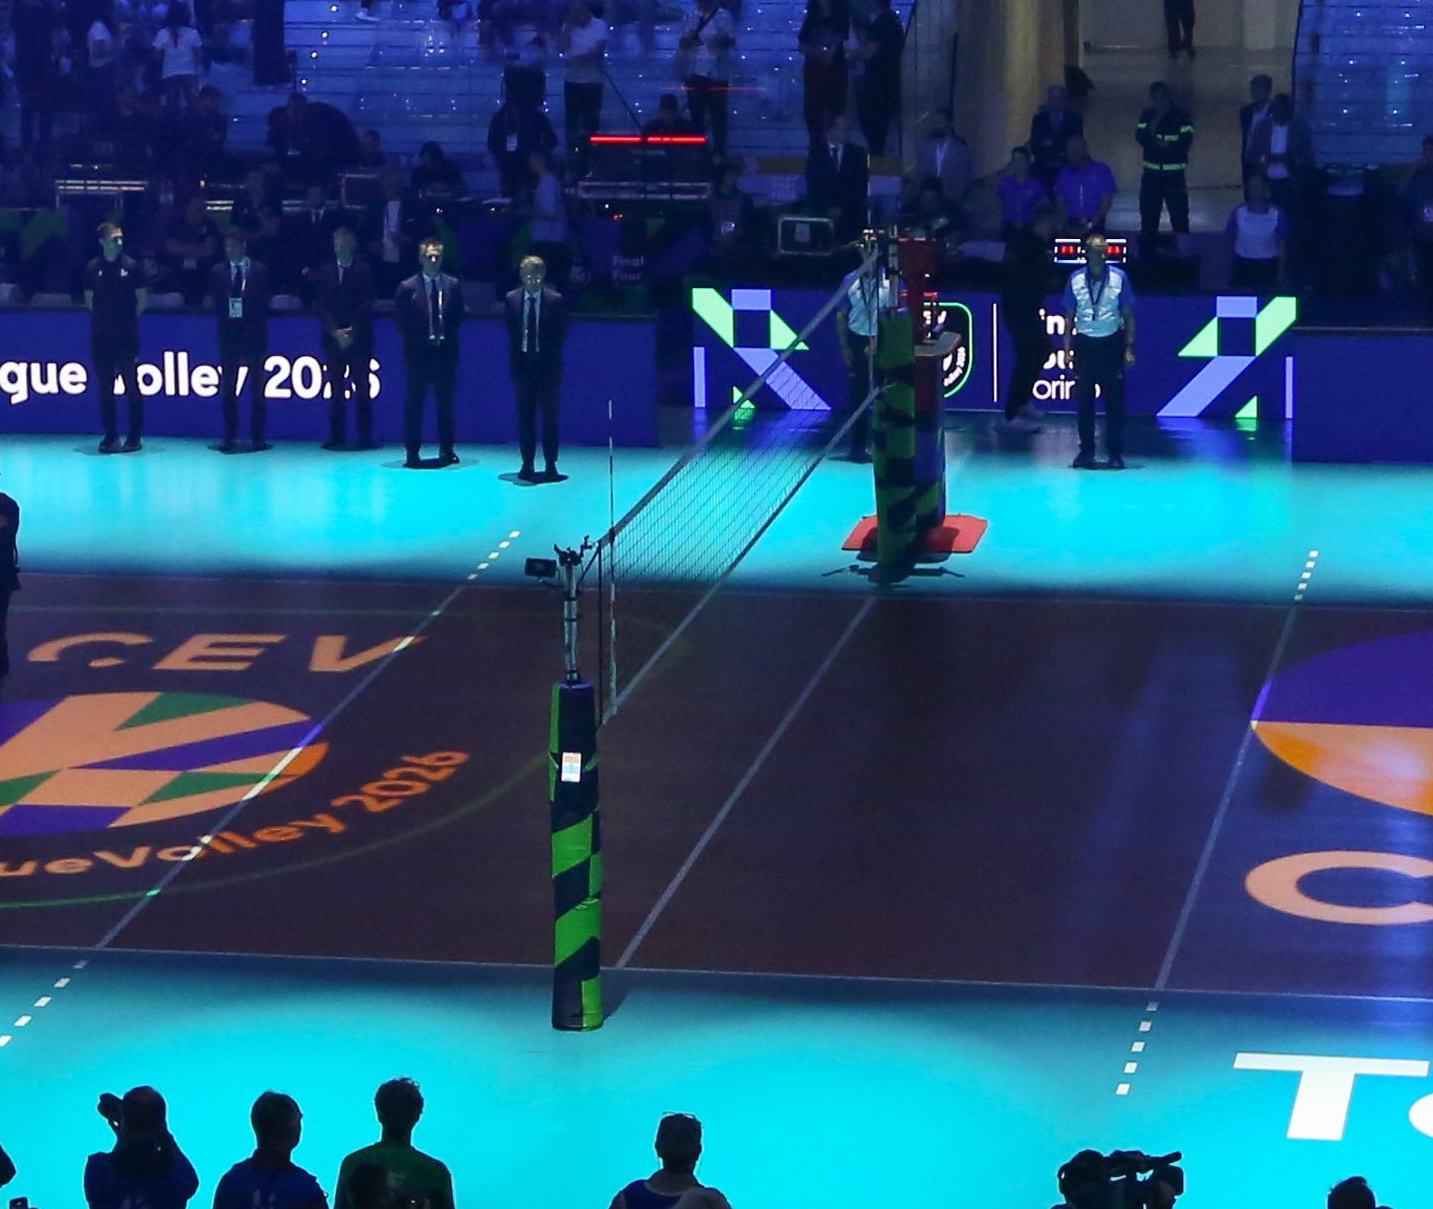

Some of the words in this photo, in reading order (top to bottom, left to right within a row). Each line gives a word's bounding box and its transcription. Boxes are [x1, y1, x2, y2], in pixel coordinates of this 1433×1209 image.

[113, 351, 249, 397] olle
[264, 355, 381, 399] 20
[331, 750, 470, 812] 2026
